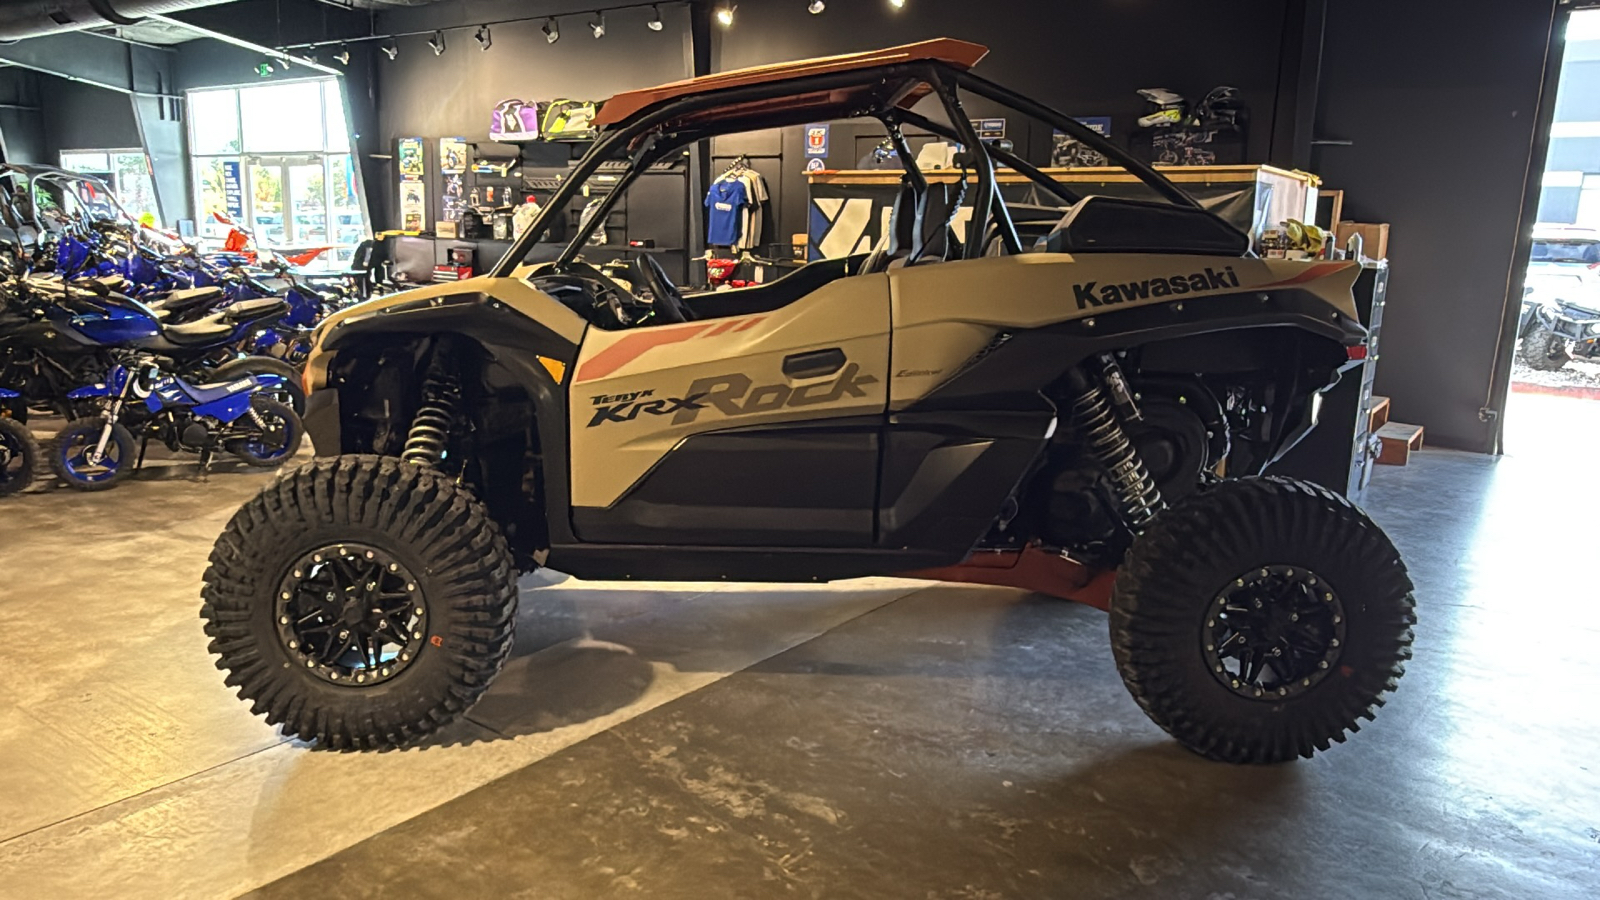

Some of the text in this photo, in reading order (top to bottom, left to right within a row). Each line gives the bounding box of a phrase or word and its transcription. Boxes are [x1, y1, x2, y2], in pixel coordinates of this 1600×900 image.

[1073, 266, 1240, 309] Kawasaki
[586, 363, 878, 428] KRX Rock
